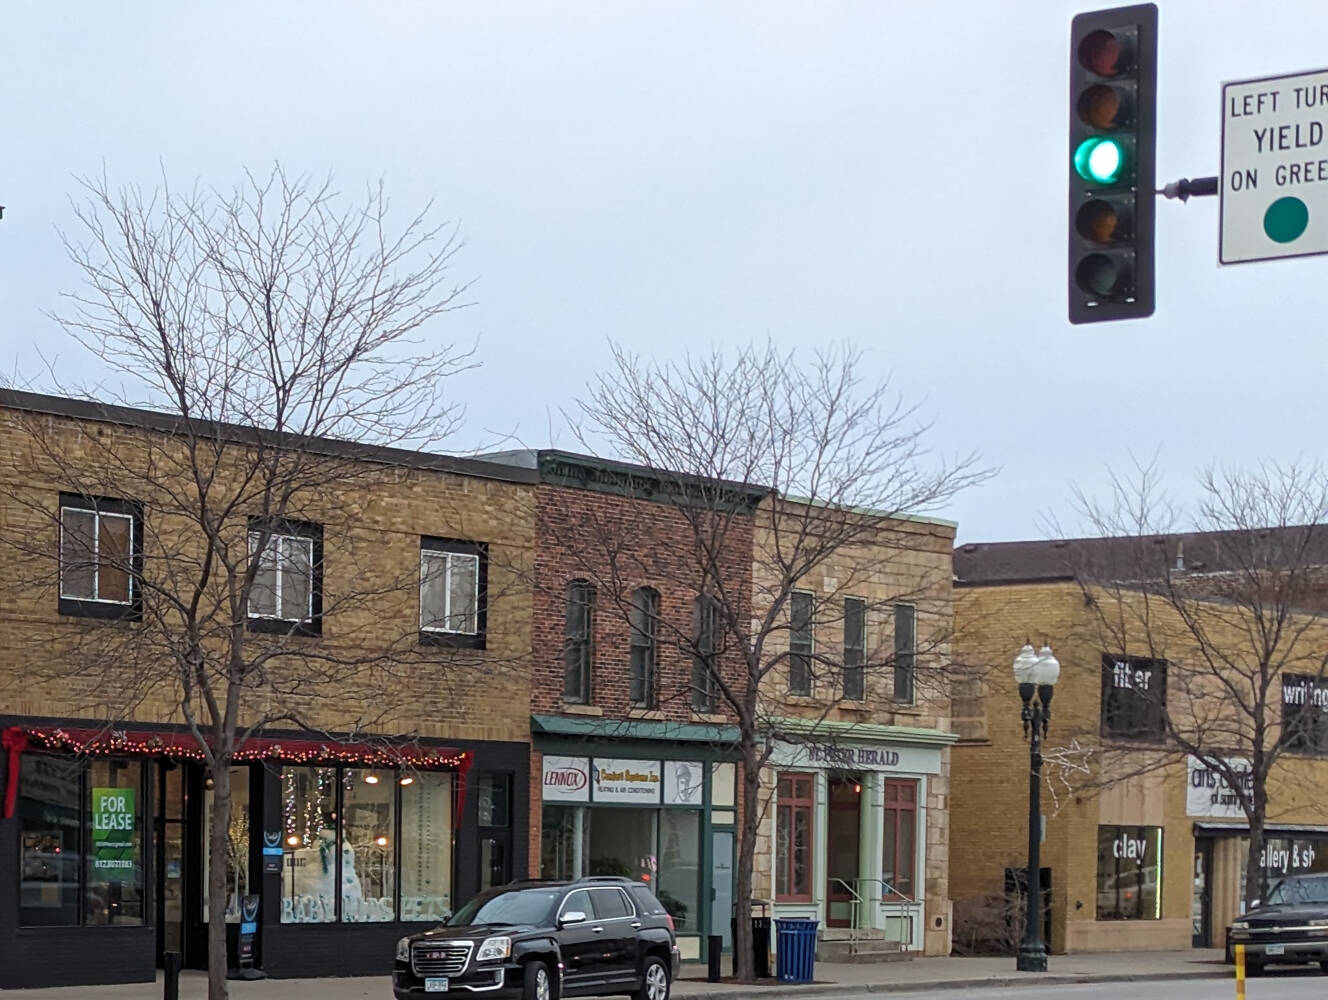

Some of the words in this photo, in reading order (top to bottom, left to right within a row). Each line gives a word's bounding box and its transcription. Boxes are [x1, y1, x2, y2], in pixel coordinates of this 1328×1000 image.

[1231, 91, 1280, 118] LEFT
[1293, 84, 1328, 109] TUR
[1253, 121, 1324, 153] YIELD
[1231, 168, 1258, 192] ON
[1275, 160, 1328, 186] GREE
[1283, 680, 1328, 713] wriing
[857, 749, 900, 766] HERALD
[544, 771, 579, 787] LENNOX
[100, 796, 126, 812] FOR
[95, 813, 132, 830] LEASE
[1113, 833, 1147, 865] clay
[1259, 844, 1289, 874] allery
[1292, 844, 1300, 868] &
[1302, 844, 1315, 868] sh
